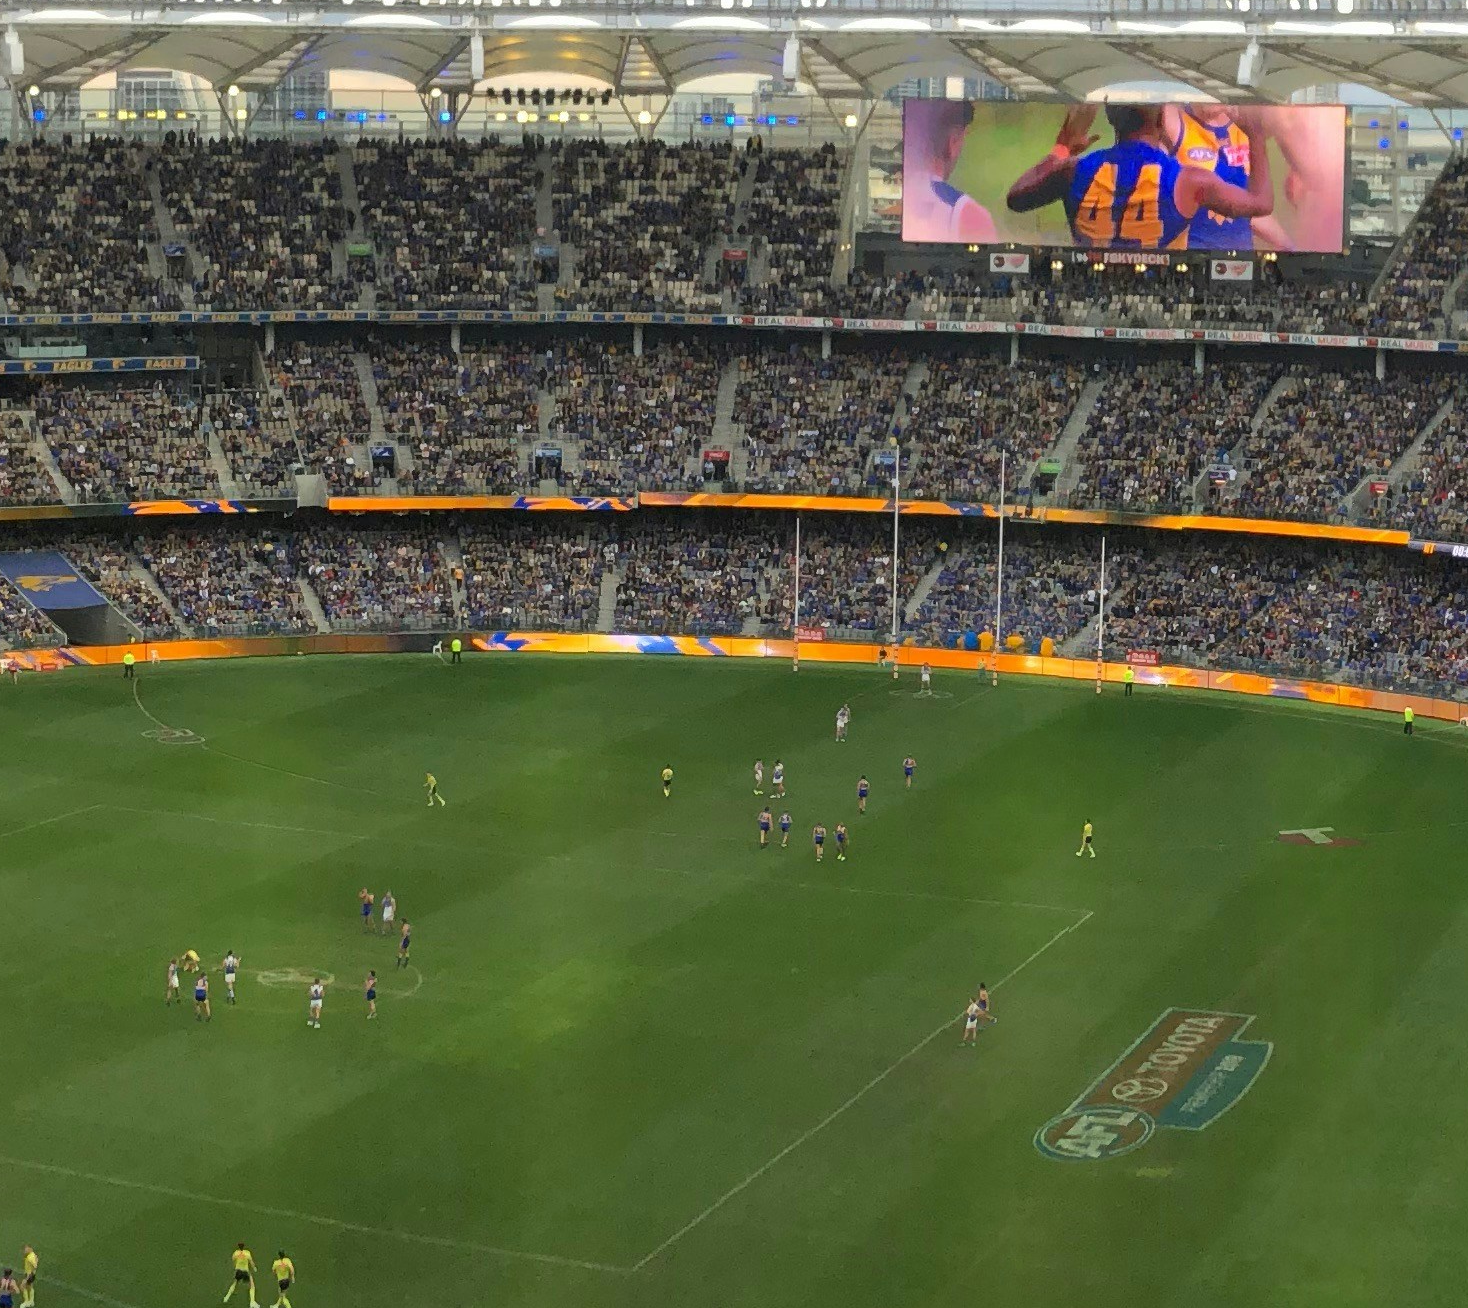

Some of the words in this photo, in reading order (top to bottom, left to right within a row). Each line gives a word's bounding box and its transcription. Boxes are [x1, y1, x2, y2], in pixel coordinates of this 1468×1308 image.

[1076, 162, 1163, 249] 44
[1137, 1017, 1224, 1073] TOYOTA
[1056, 1111, 1138, 1158] AFL
